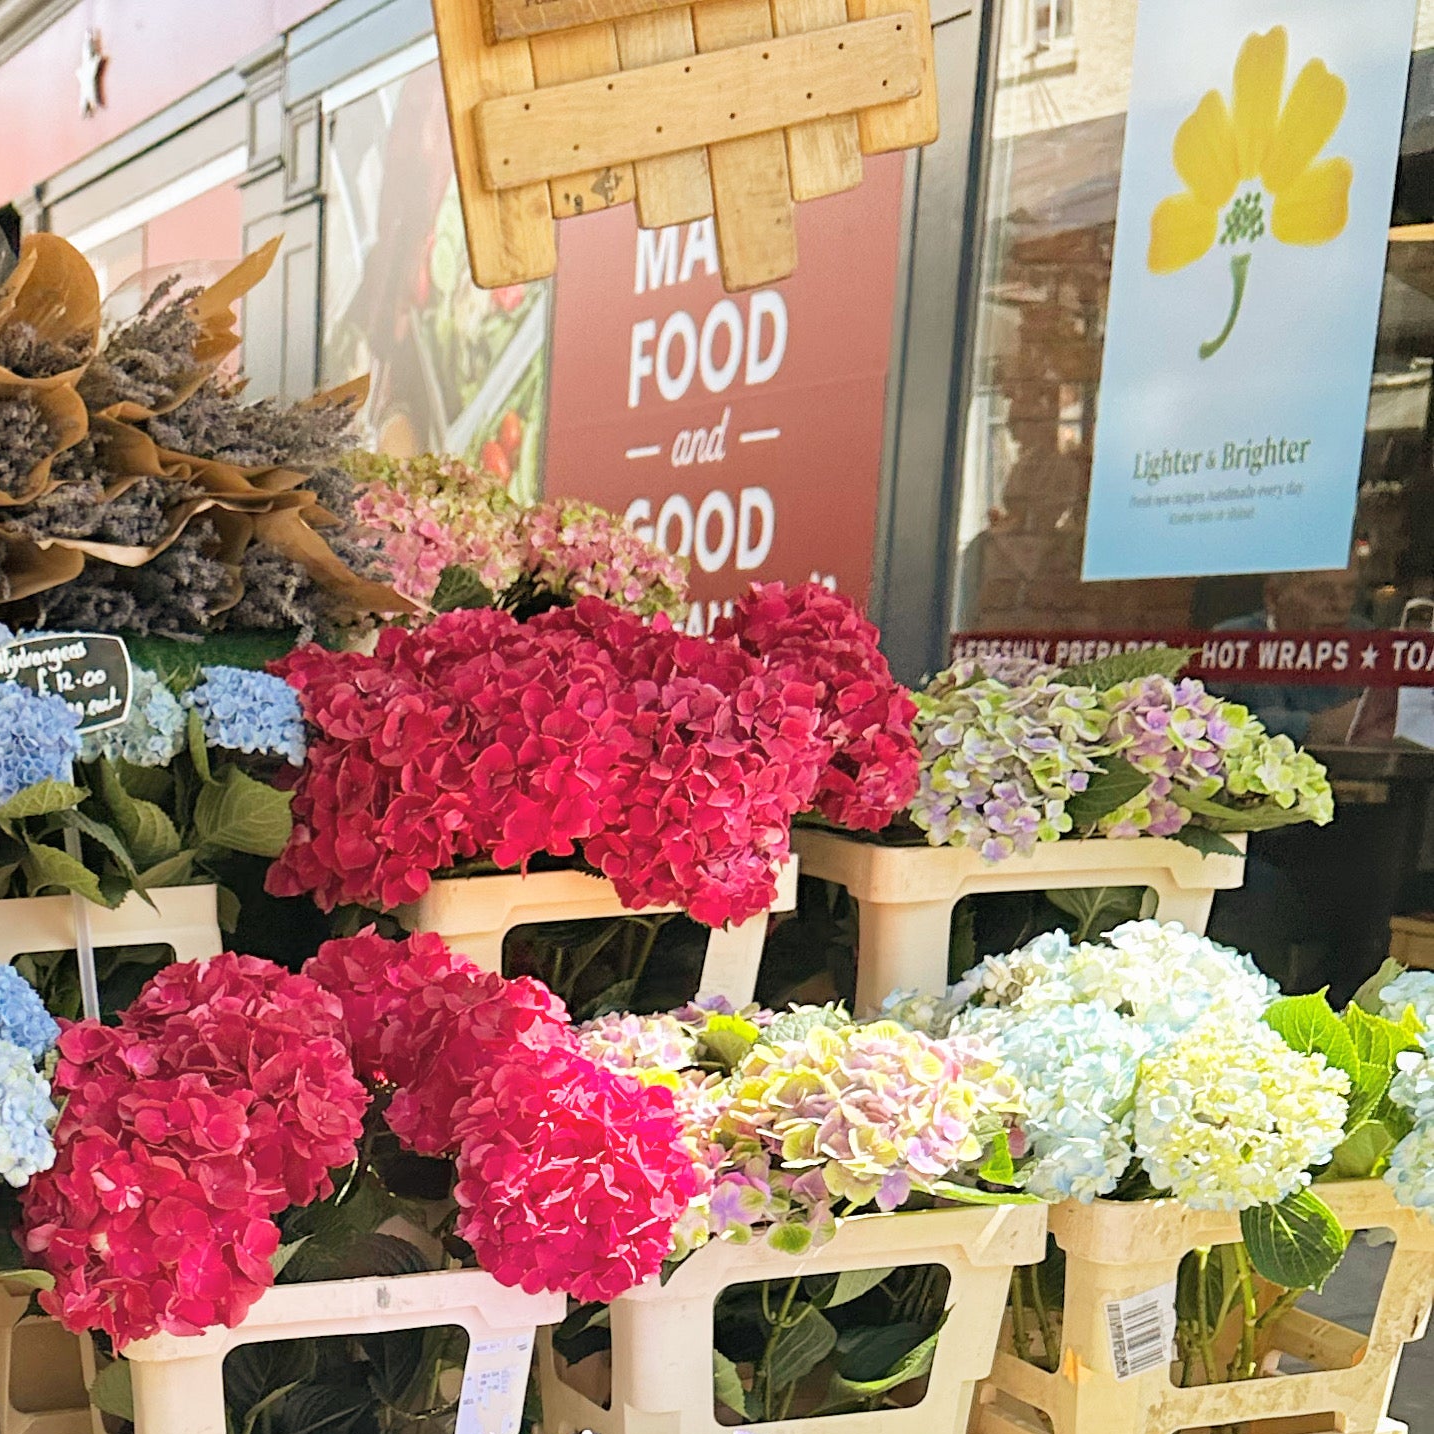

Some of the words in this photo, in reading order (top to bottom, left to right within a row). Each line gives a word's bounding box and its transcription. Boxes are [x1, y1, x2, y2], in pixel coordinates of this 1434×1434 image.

[634, 216, 720, 294] MA
[628, 289, 788, 408] FOOD
[671, 404, 731, 467] and
[1133, 449, 1203, 486] Lighter
[1206, 451, 1216, 469] &
[1222, 435, 1312, 477] Brighter
[624, 486, 775, 573] GOOD
[1200, 640, 1251, 670] HOT
[1258, 640, 1350, 671] WRAPS
